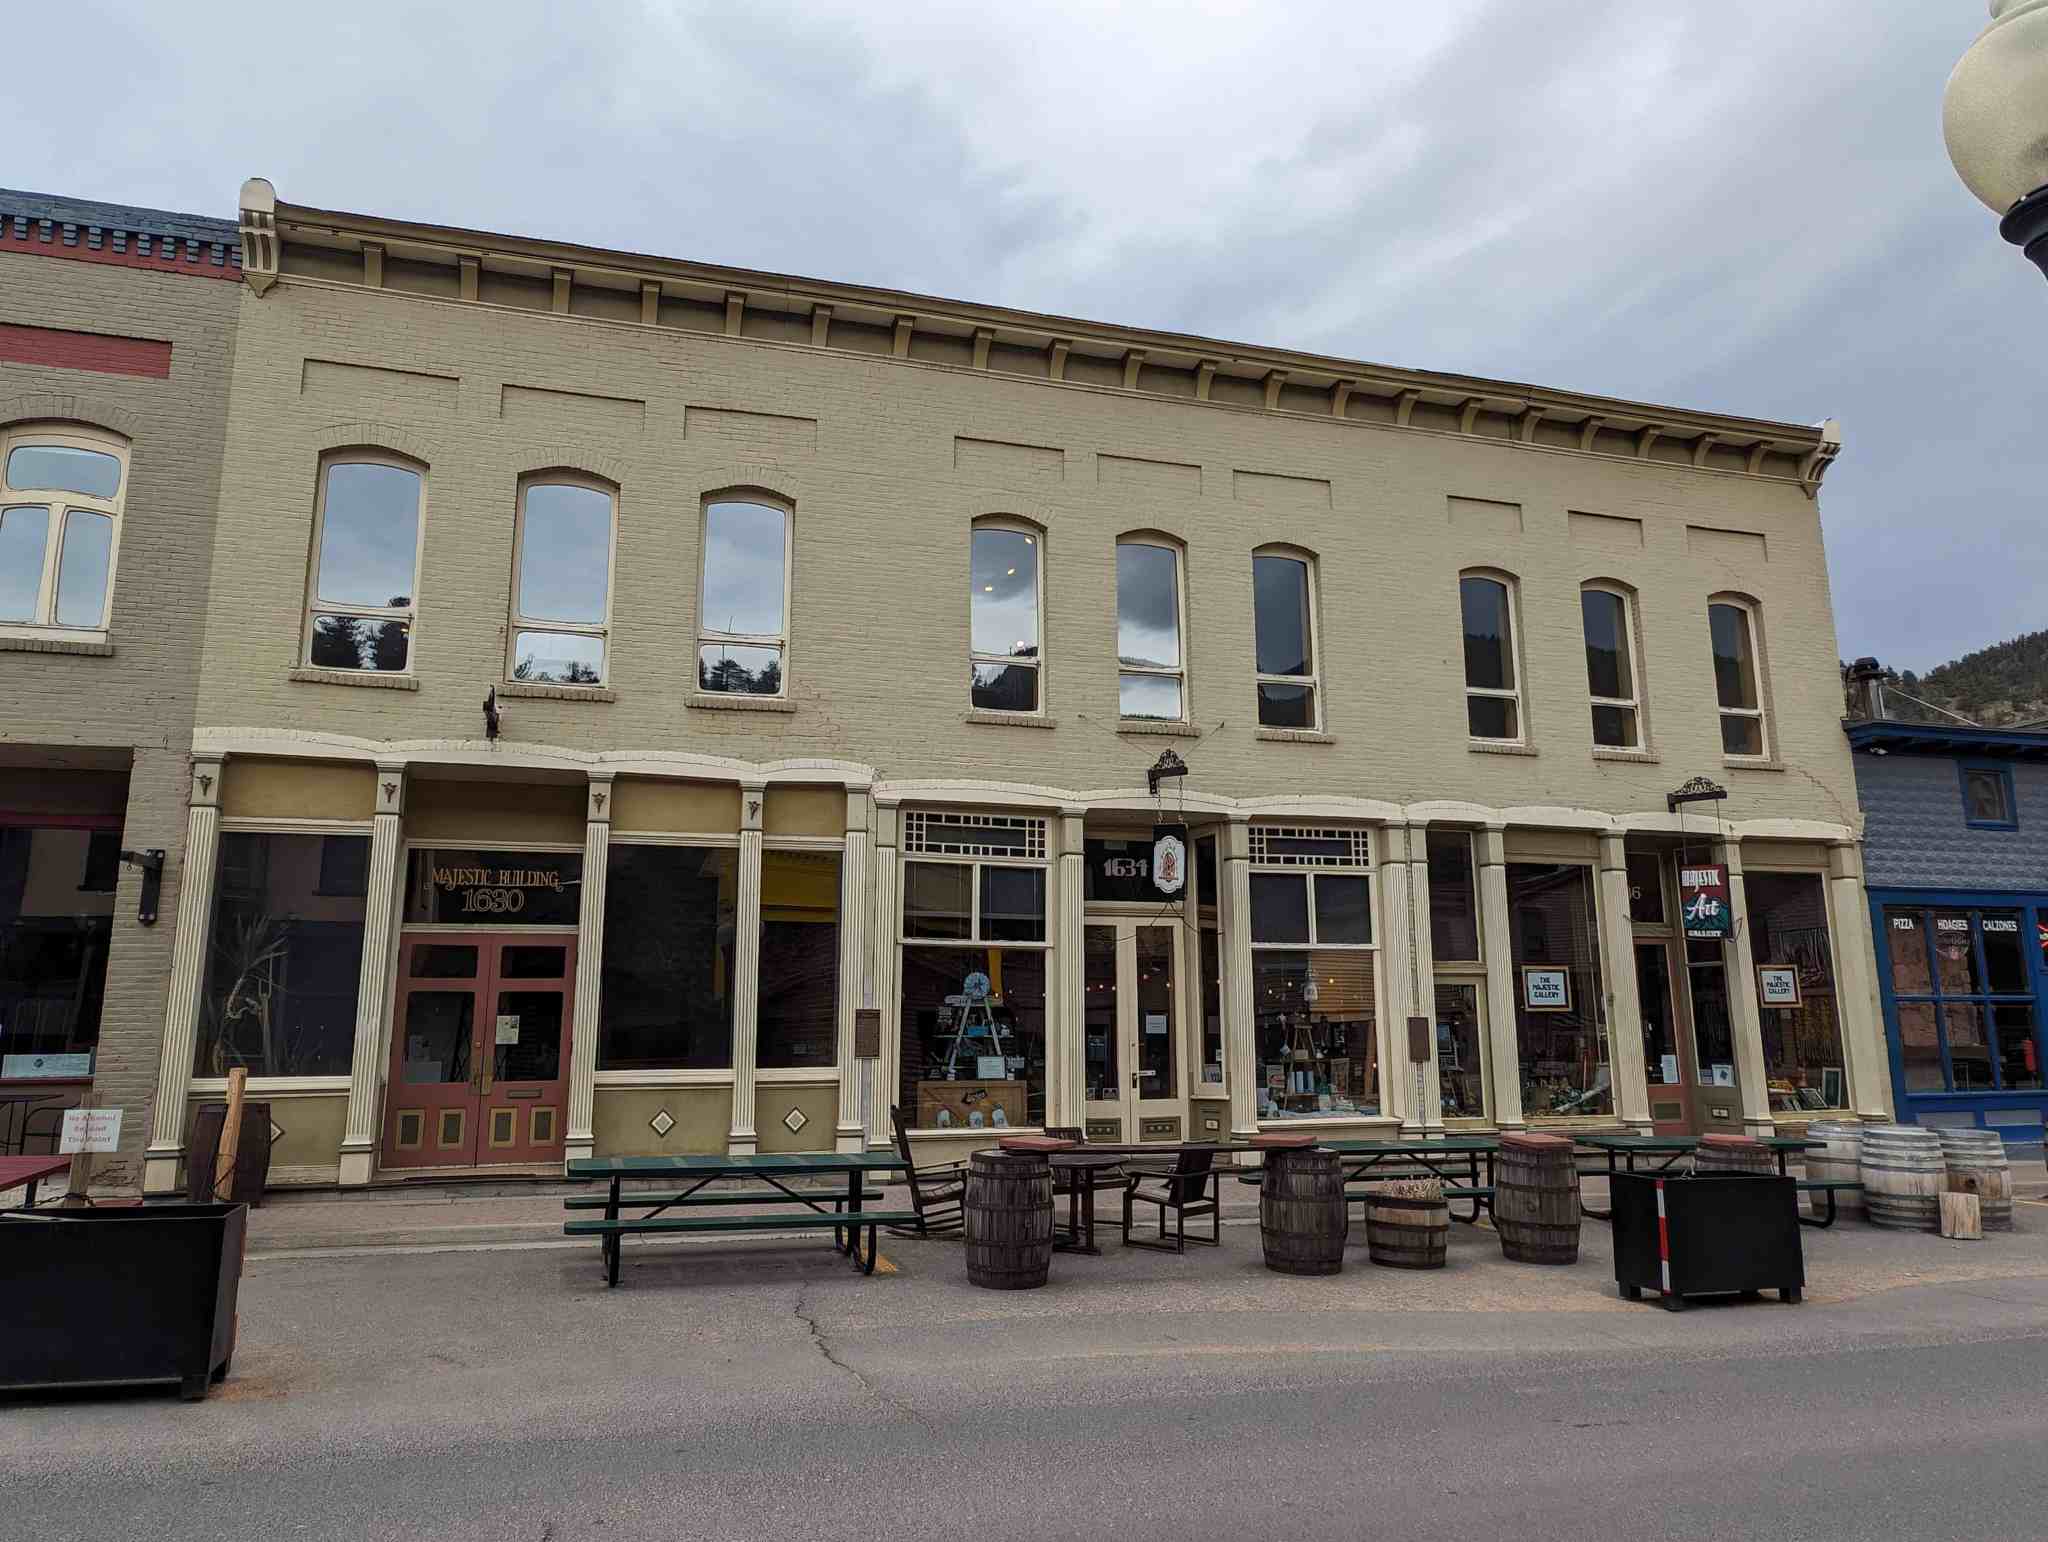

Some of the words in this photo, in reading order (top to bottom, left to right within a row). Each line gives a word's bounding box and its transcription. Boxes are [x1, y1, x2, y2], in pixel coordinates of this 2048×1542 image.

[432, 867, 491, 889] MAJESTIC
[499, 868, 562, 890] BUILDING
[1681, 869, 1720, 891] MAJESTIC
[461, 888, 525, 912] 1630
[1685, 893, 1720, 920] Art
[1892, 918, 1914, 930] PIZZA
[1937, 919, 1968, 931] HOAGIES
[1982, 919, 2018, 932] CALZONES
